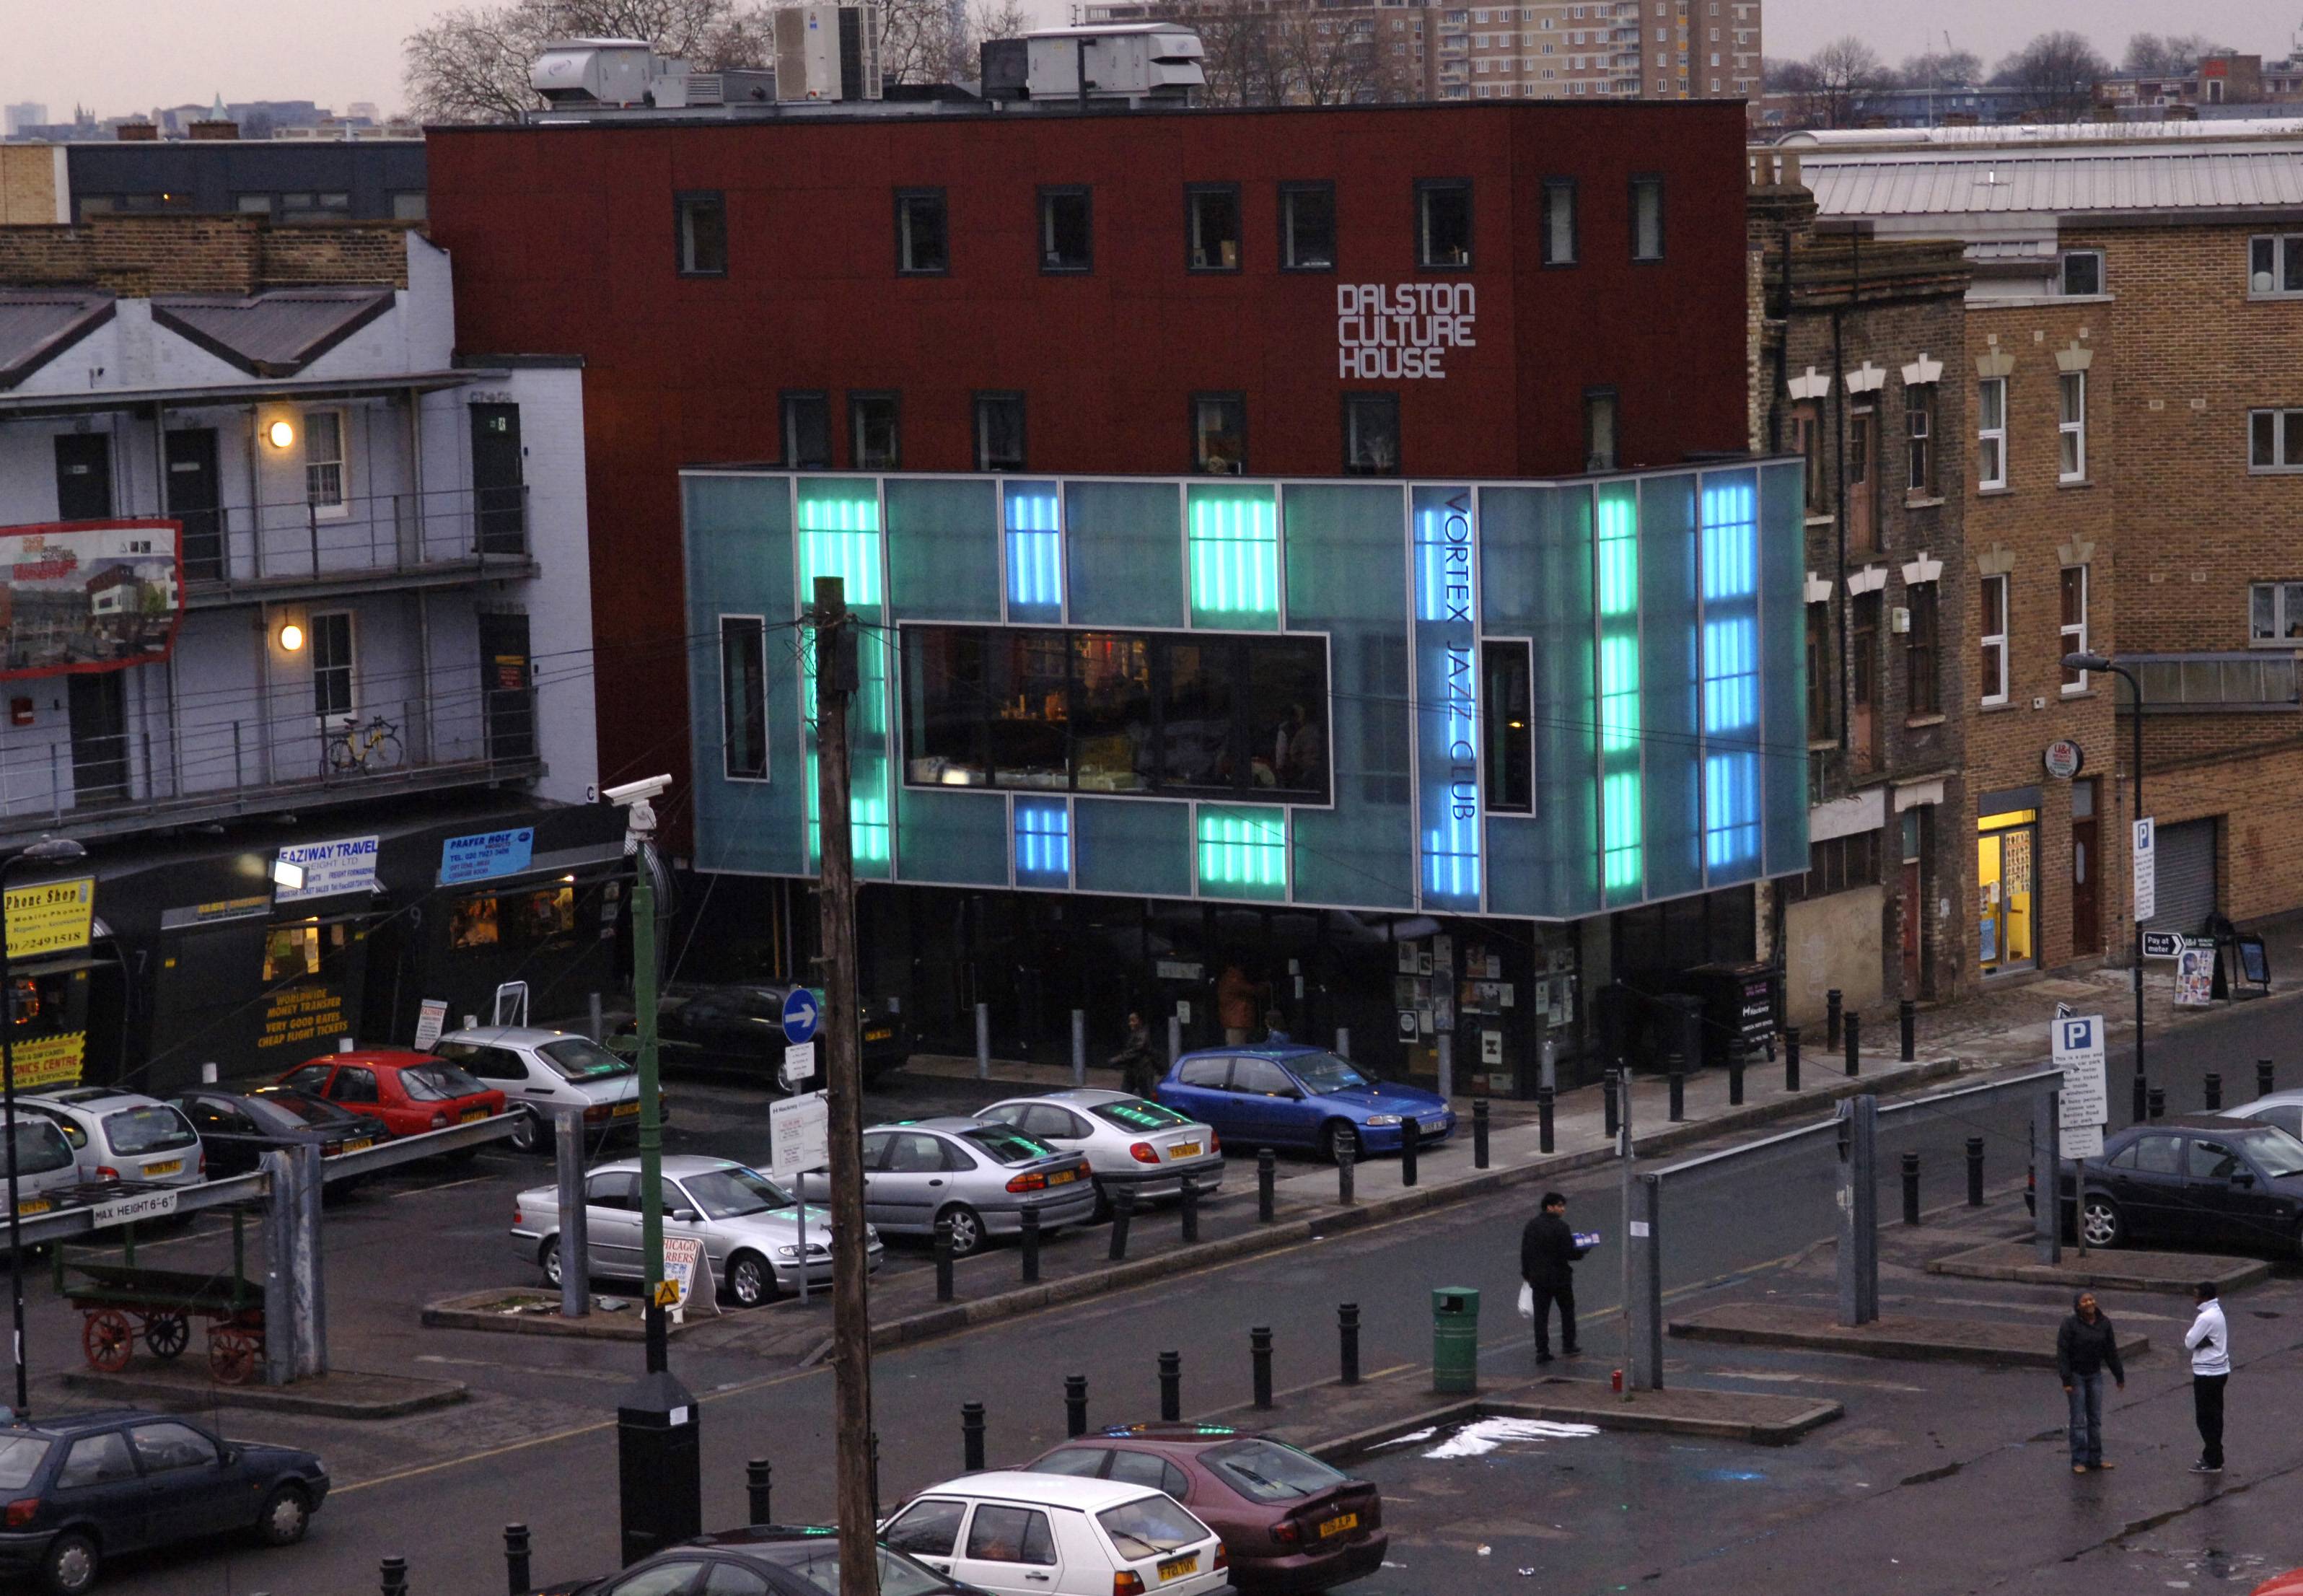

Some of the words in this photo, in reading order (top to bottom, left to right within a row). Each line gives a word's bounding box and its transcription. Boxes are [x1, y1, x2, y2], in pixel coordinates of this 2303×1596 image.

[1338, 283, 1475, 315] DALSTON
[1338, 315, 1476, 346] CULTURE
[1339, 347, 1446, 379] HOUSE
[1444, 493, 1470, 623] VORTEX
[1447, 641, 1473, 722] JAZZ
[1450, 740, 1475, 821] CLUB
[450, 838, 485, 849] PRAYER
[488, 833, 511, 843] HOLY
[2140, 825, 2147, 848] P
[336, 840, 378, 857] TRAVEL
[342, 857, 358, 867] LTD
[6, 895, 41, 910] Phone
[47, 889, 76, 903] Shop
[267, 1004, 298, 1018] MONEY
[300, 996, 341, 1012] TRANSFER
[276, 988, 328, 1006] WORLDWIDE
[266, 1021, 287, 1033] VERY
[290, 1016, 314, 1028] GOOD
[316, 1012, 341, 1024] RATES
[258, 1033, 286, 1048] CHEAP
[287, 1027, 315, 1042] FLIGHT
[317, 1020, 348, 1035] TICKETS
[2069, 1022, 2087, 1048] P
[43, 1055, 78, 1071] CENTRE
[95, 1207, 114, 1222] MAX
[117, 1201, 149, 1216] HEIGHT
[664, 1239, 698, 1251] HICAGO
[665, 1251, 694, 1264] RBERS
